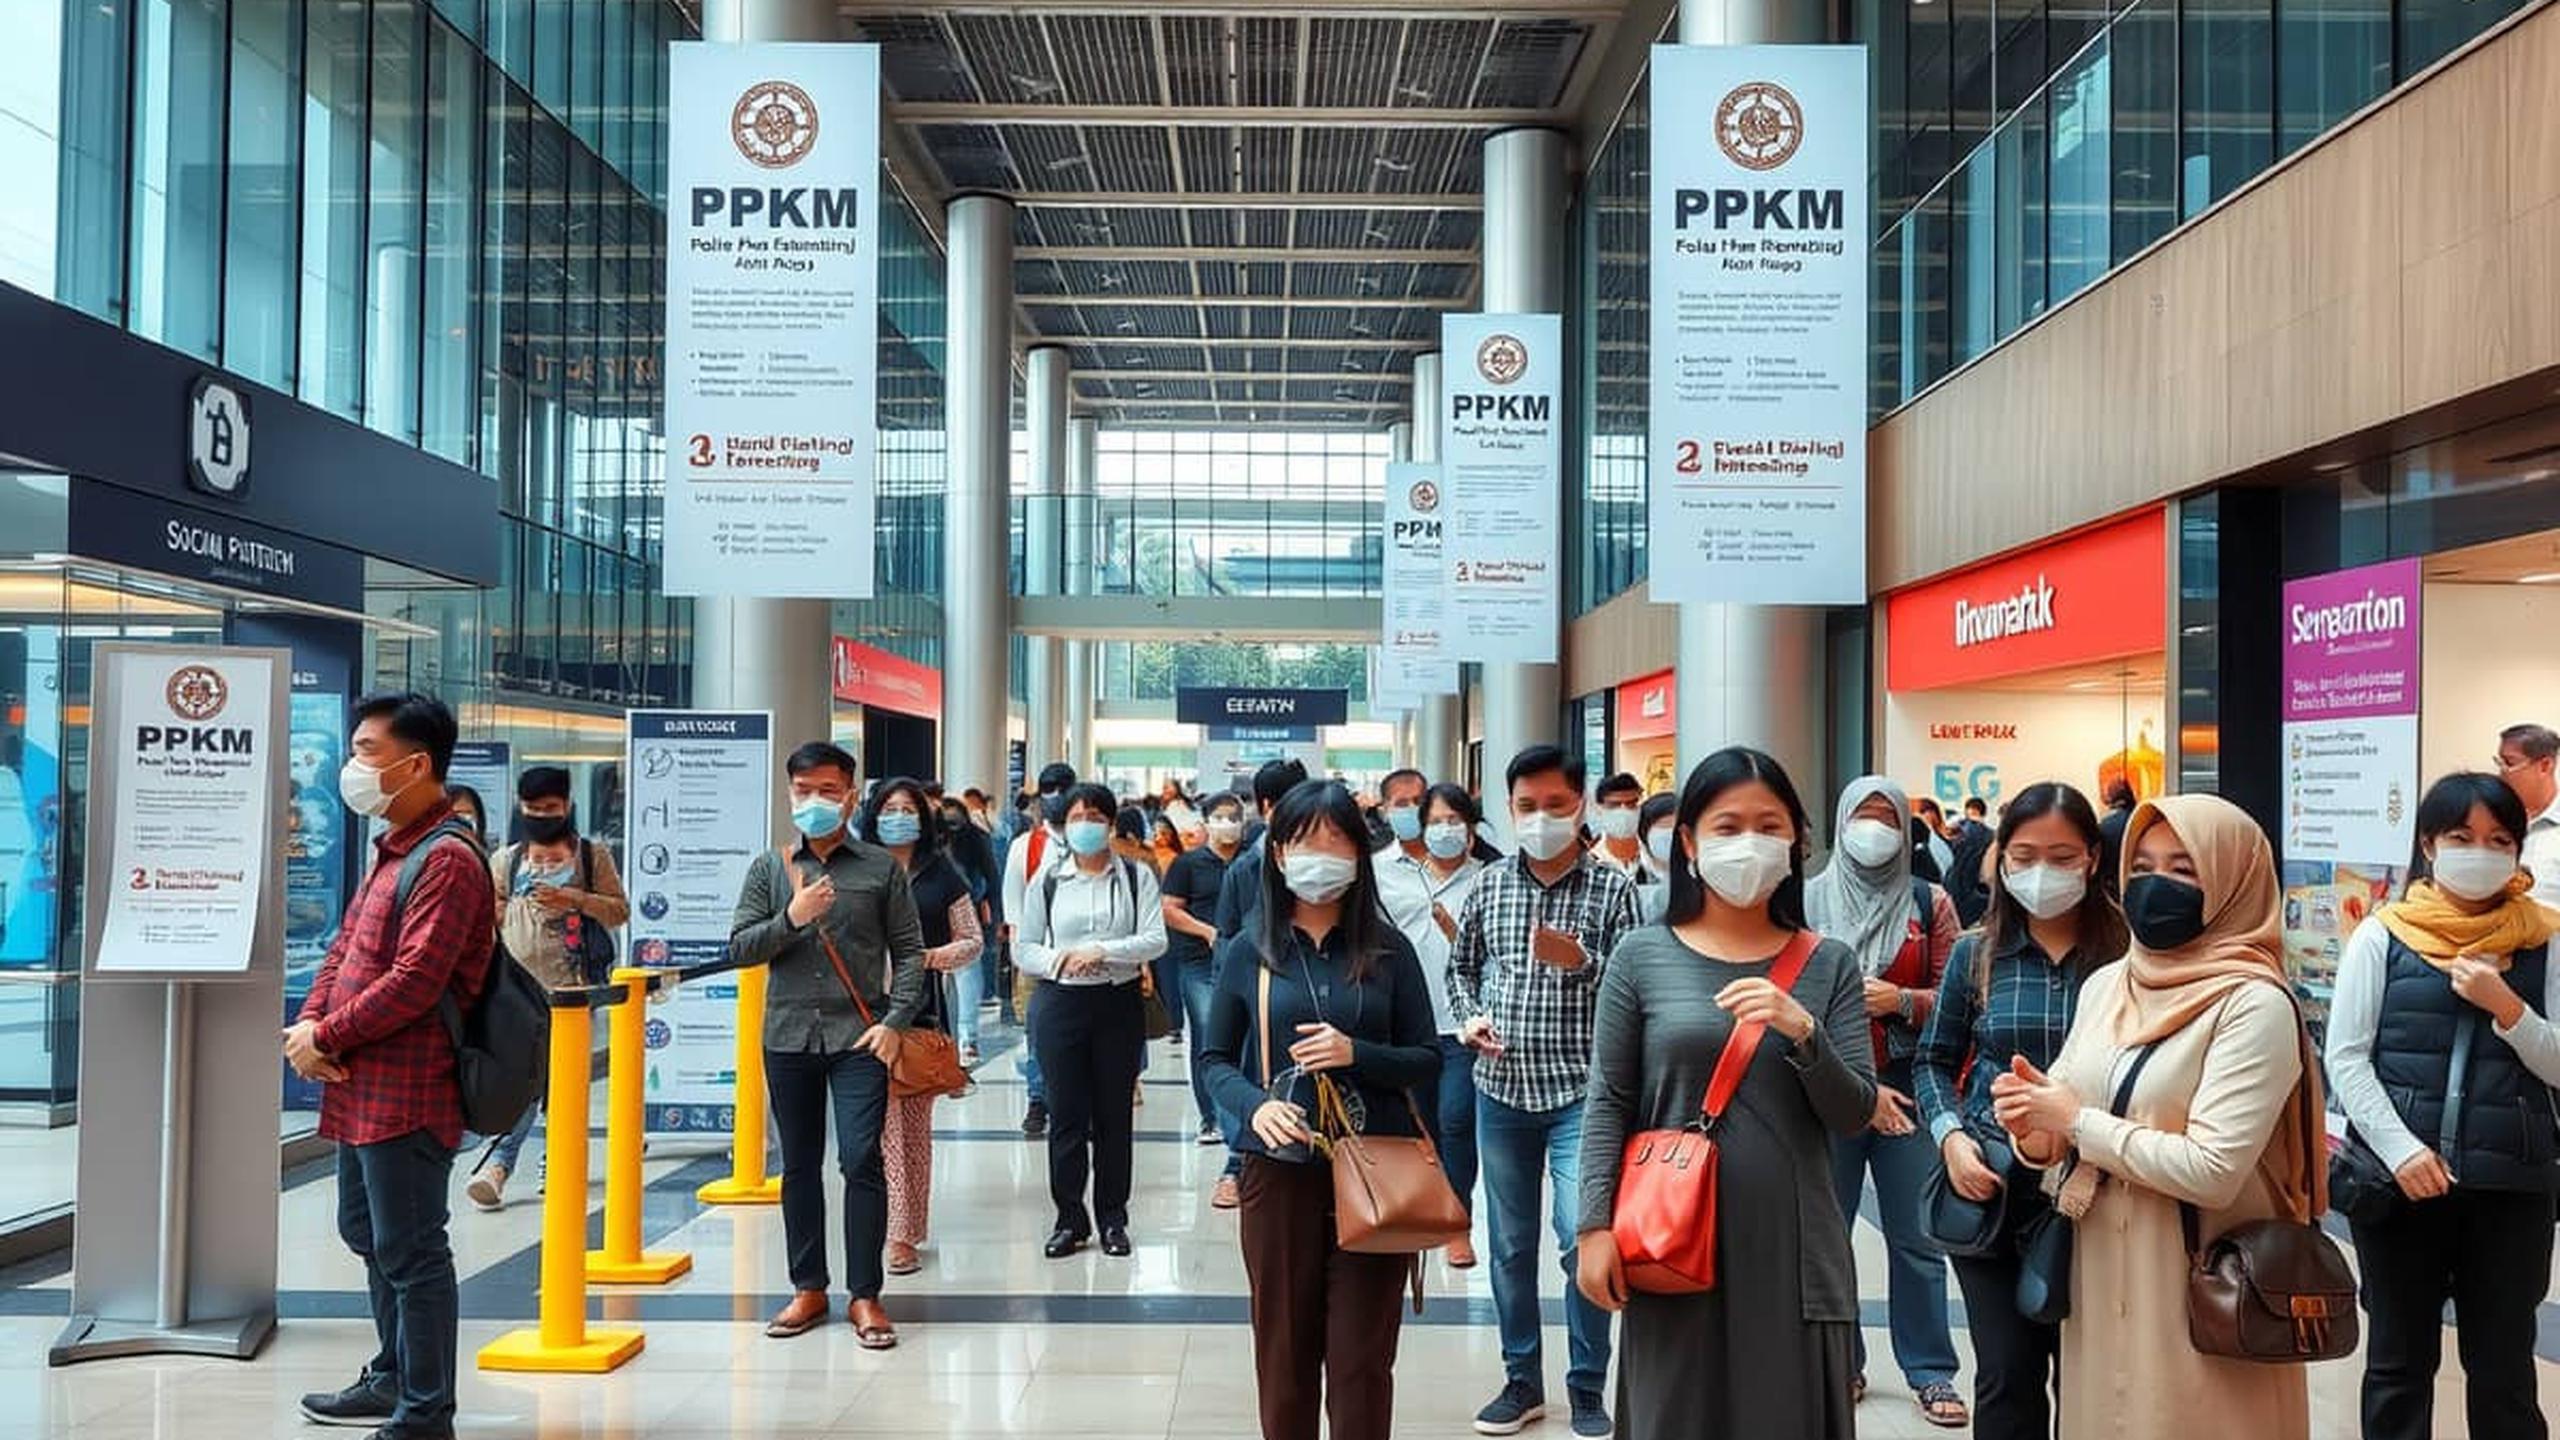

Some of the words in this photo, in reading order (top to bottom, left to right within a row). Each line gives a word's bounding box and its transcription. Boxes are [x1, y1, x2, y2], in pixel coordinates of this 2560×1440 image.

[691, 187, 858, 228] PPKM
[1674, 189, 1844, 230] PPKM
[1453, 394, 1550, 421] PPKM
[1676, 440, 1702, 474] 2
[137, 726, 252, 755] PPKM
